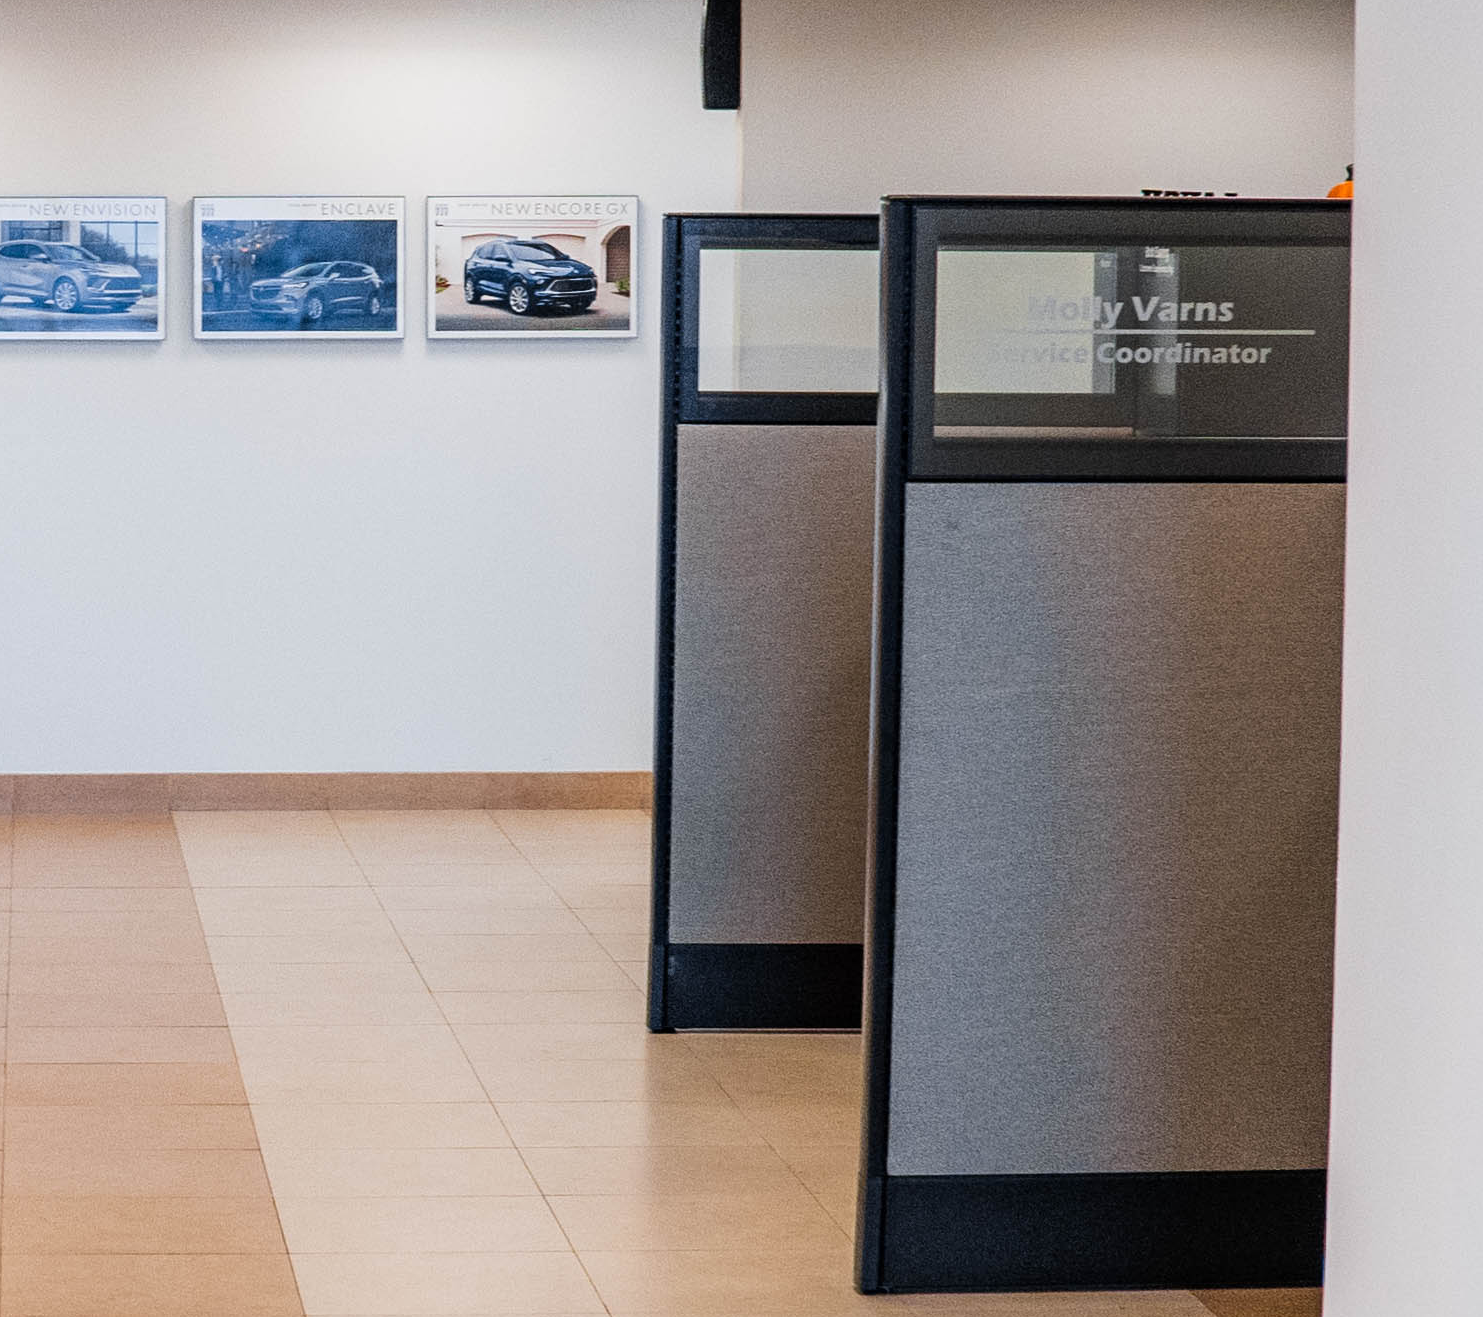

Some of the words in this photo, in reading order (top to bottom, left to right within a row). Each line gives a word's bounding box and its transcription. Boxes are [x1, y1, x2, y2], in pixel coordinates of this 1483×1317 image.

[28, 203, 70, 217] NEW
[72, 203, 157, 217] ENVISION
[320, 202, 397, 216] ENCLAVE
[490, 202, 531, 216] NEW
[534, 202, 603, 216] ENCORE
[605, 202, 629, 216] GX
[1131, 295, 1235, 323] Varns
[1095, 341, 1273, 365] Coordinator
